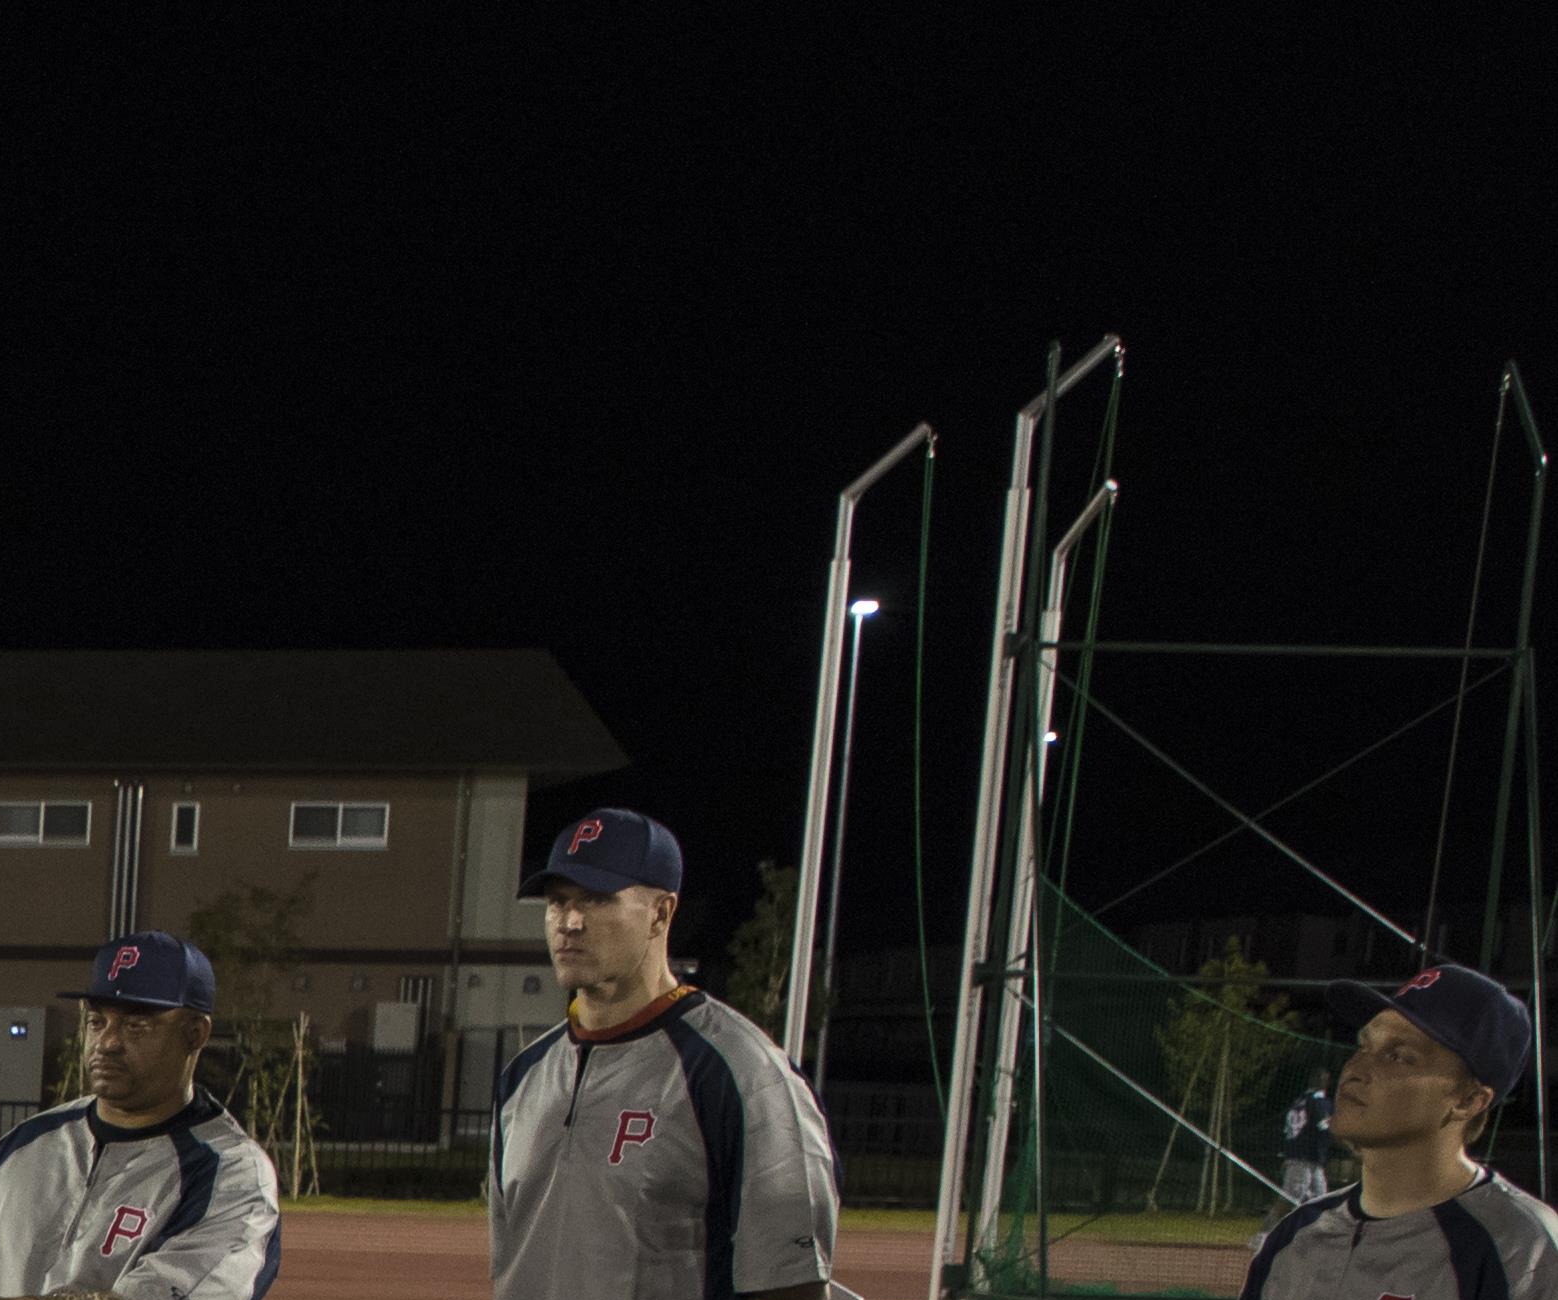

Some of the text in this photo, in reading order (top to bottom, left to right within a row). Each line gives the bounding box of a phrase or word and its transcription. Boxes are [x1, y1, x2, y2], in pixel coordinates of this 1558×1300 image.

[567, 819, 603, 854] P
[108, 945, 140, 980] P
[1395, 967, 1441, 996] P
[609, 1109, 656, 1164] P
[101, 1206, 148, 1256] P
